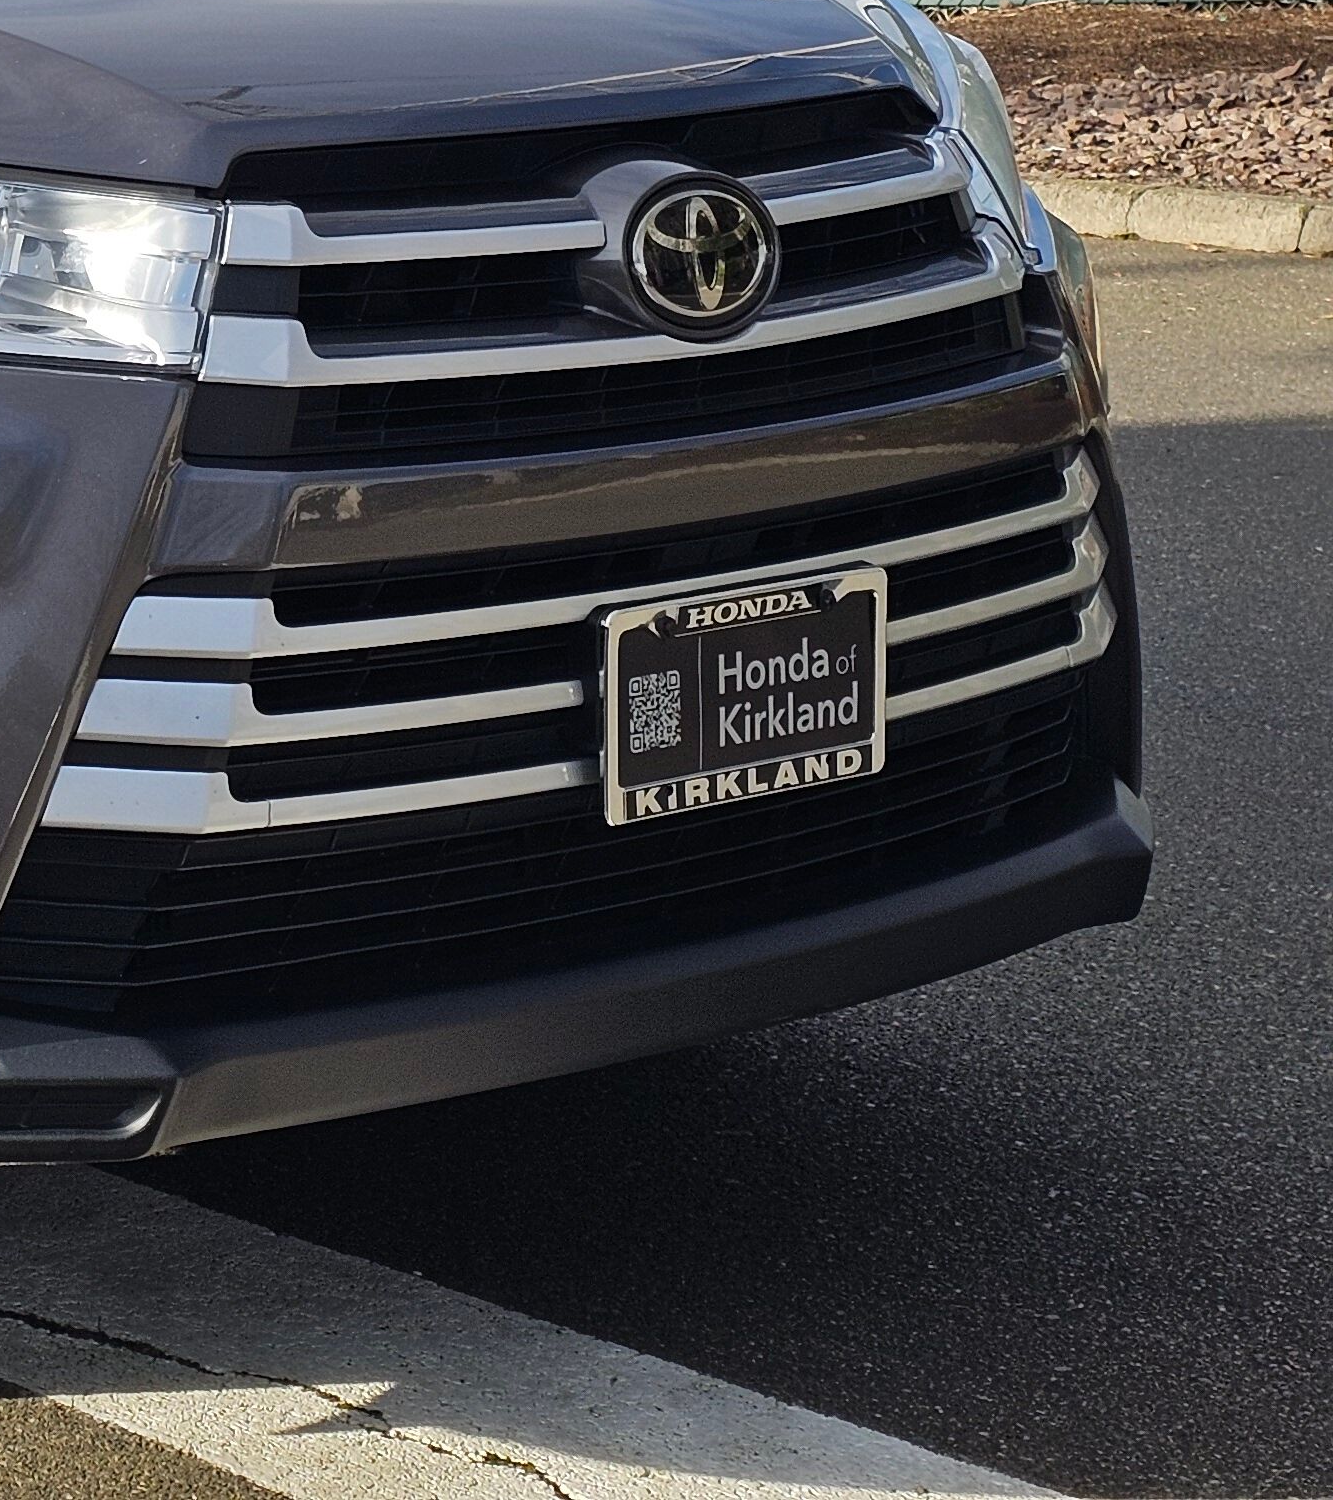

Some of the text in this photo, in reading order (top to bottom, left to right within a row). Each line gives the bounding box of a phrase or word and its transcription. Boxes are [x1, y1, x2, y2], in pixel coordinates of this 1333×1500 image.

[686, 590, 812, 629] HONDA
[718, 636, 858, 695] Honda of
[718, 681, 859, 747] Kirkland
[636, 749, 863, 817] KIRKLAND
